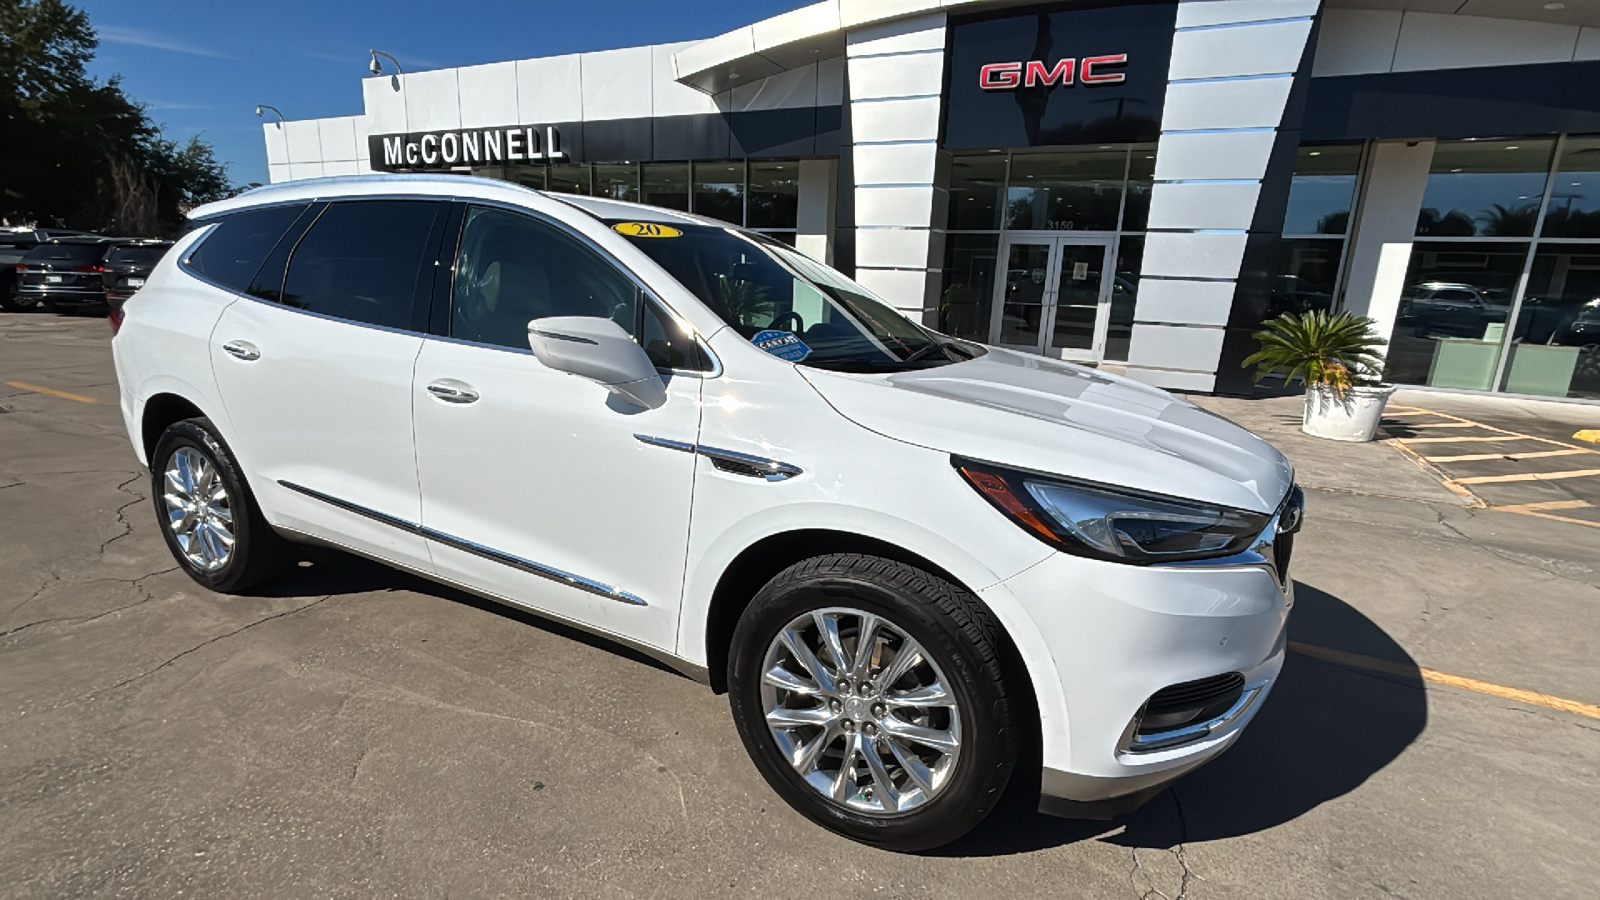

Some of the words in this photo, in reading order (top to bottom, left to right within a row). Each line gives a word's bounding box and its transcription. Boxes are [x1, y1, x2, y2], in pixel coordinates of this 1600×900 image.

[980, 53, 1128, 90] GMC
[383, 126, 563, 166] McCONNELL
[631, 223, 661, 236] 20
[1047, 220, 1074, 230] 3150
[759, 335, 799, 349] CARFAX
